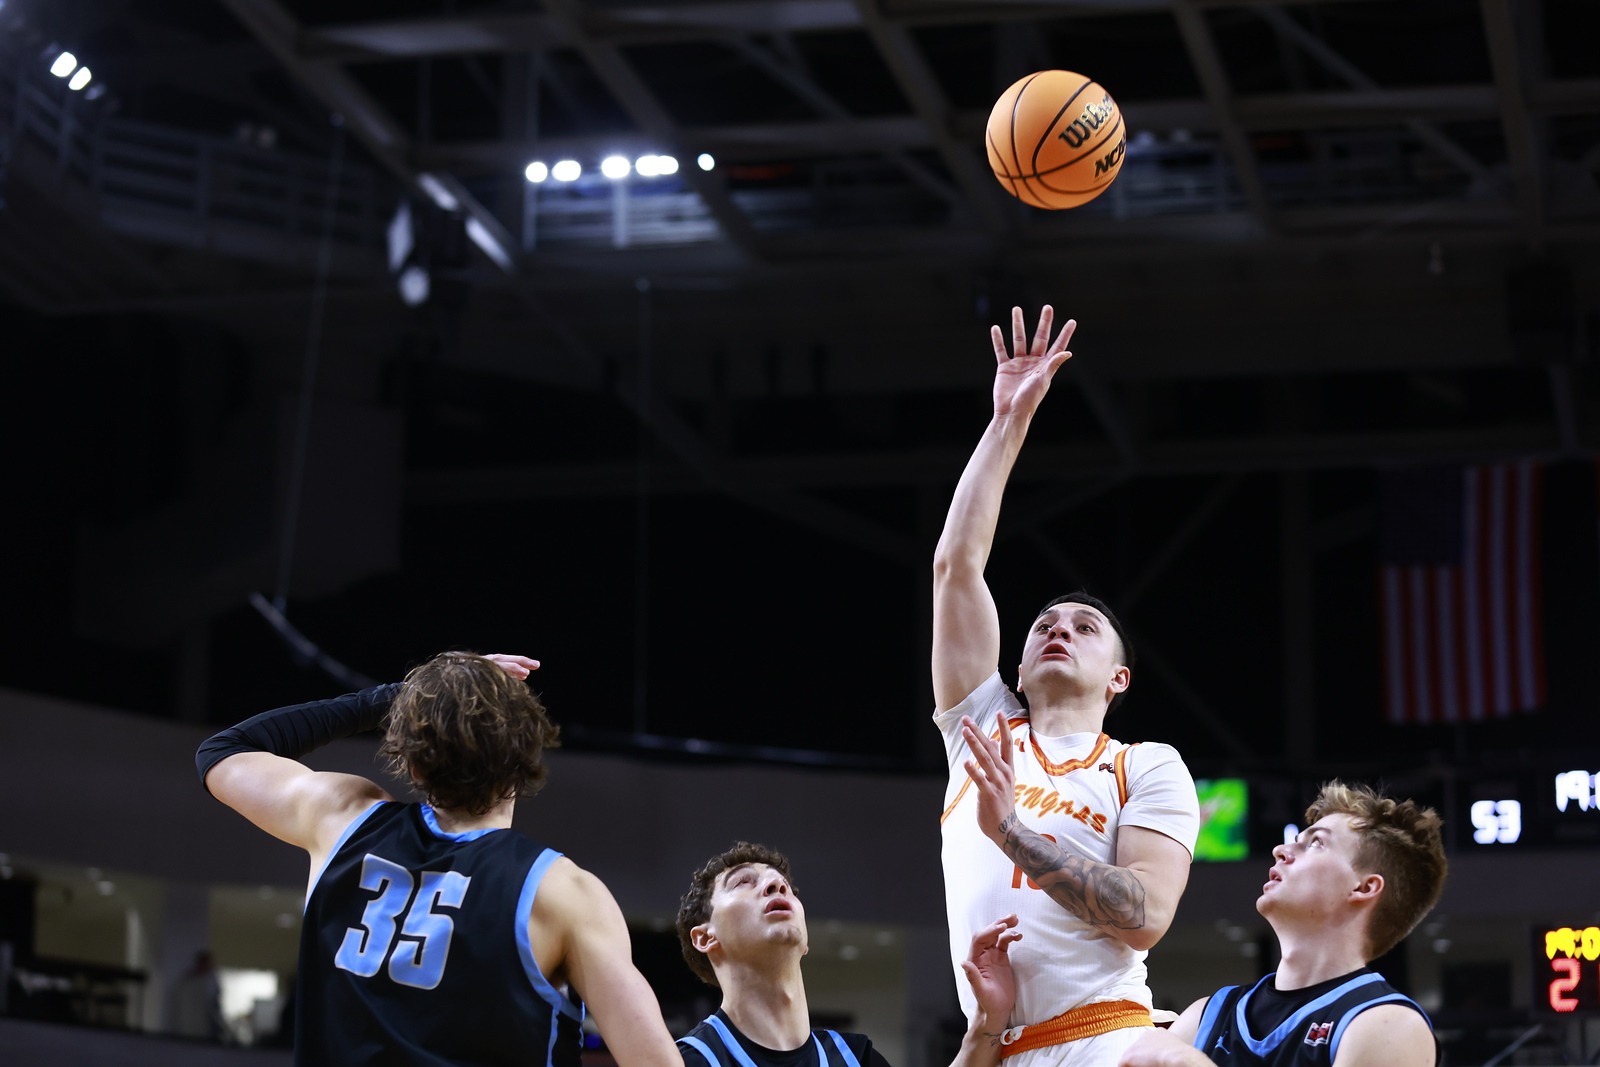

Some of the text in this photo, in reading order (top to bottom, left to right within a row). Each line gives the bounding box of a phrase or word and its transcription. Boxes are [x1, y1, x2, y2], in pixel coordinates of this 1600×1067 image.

[1058, 93, 1115, 148] Wilso
[1555, 770, 1600, 812] 19:
[1471, 800, 1521, 844] 53
[334, 853, 472, 990] 35
[1549, 958, 1600, 1012] 2
